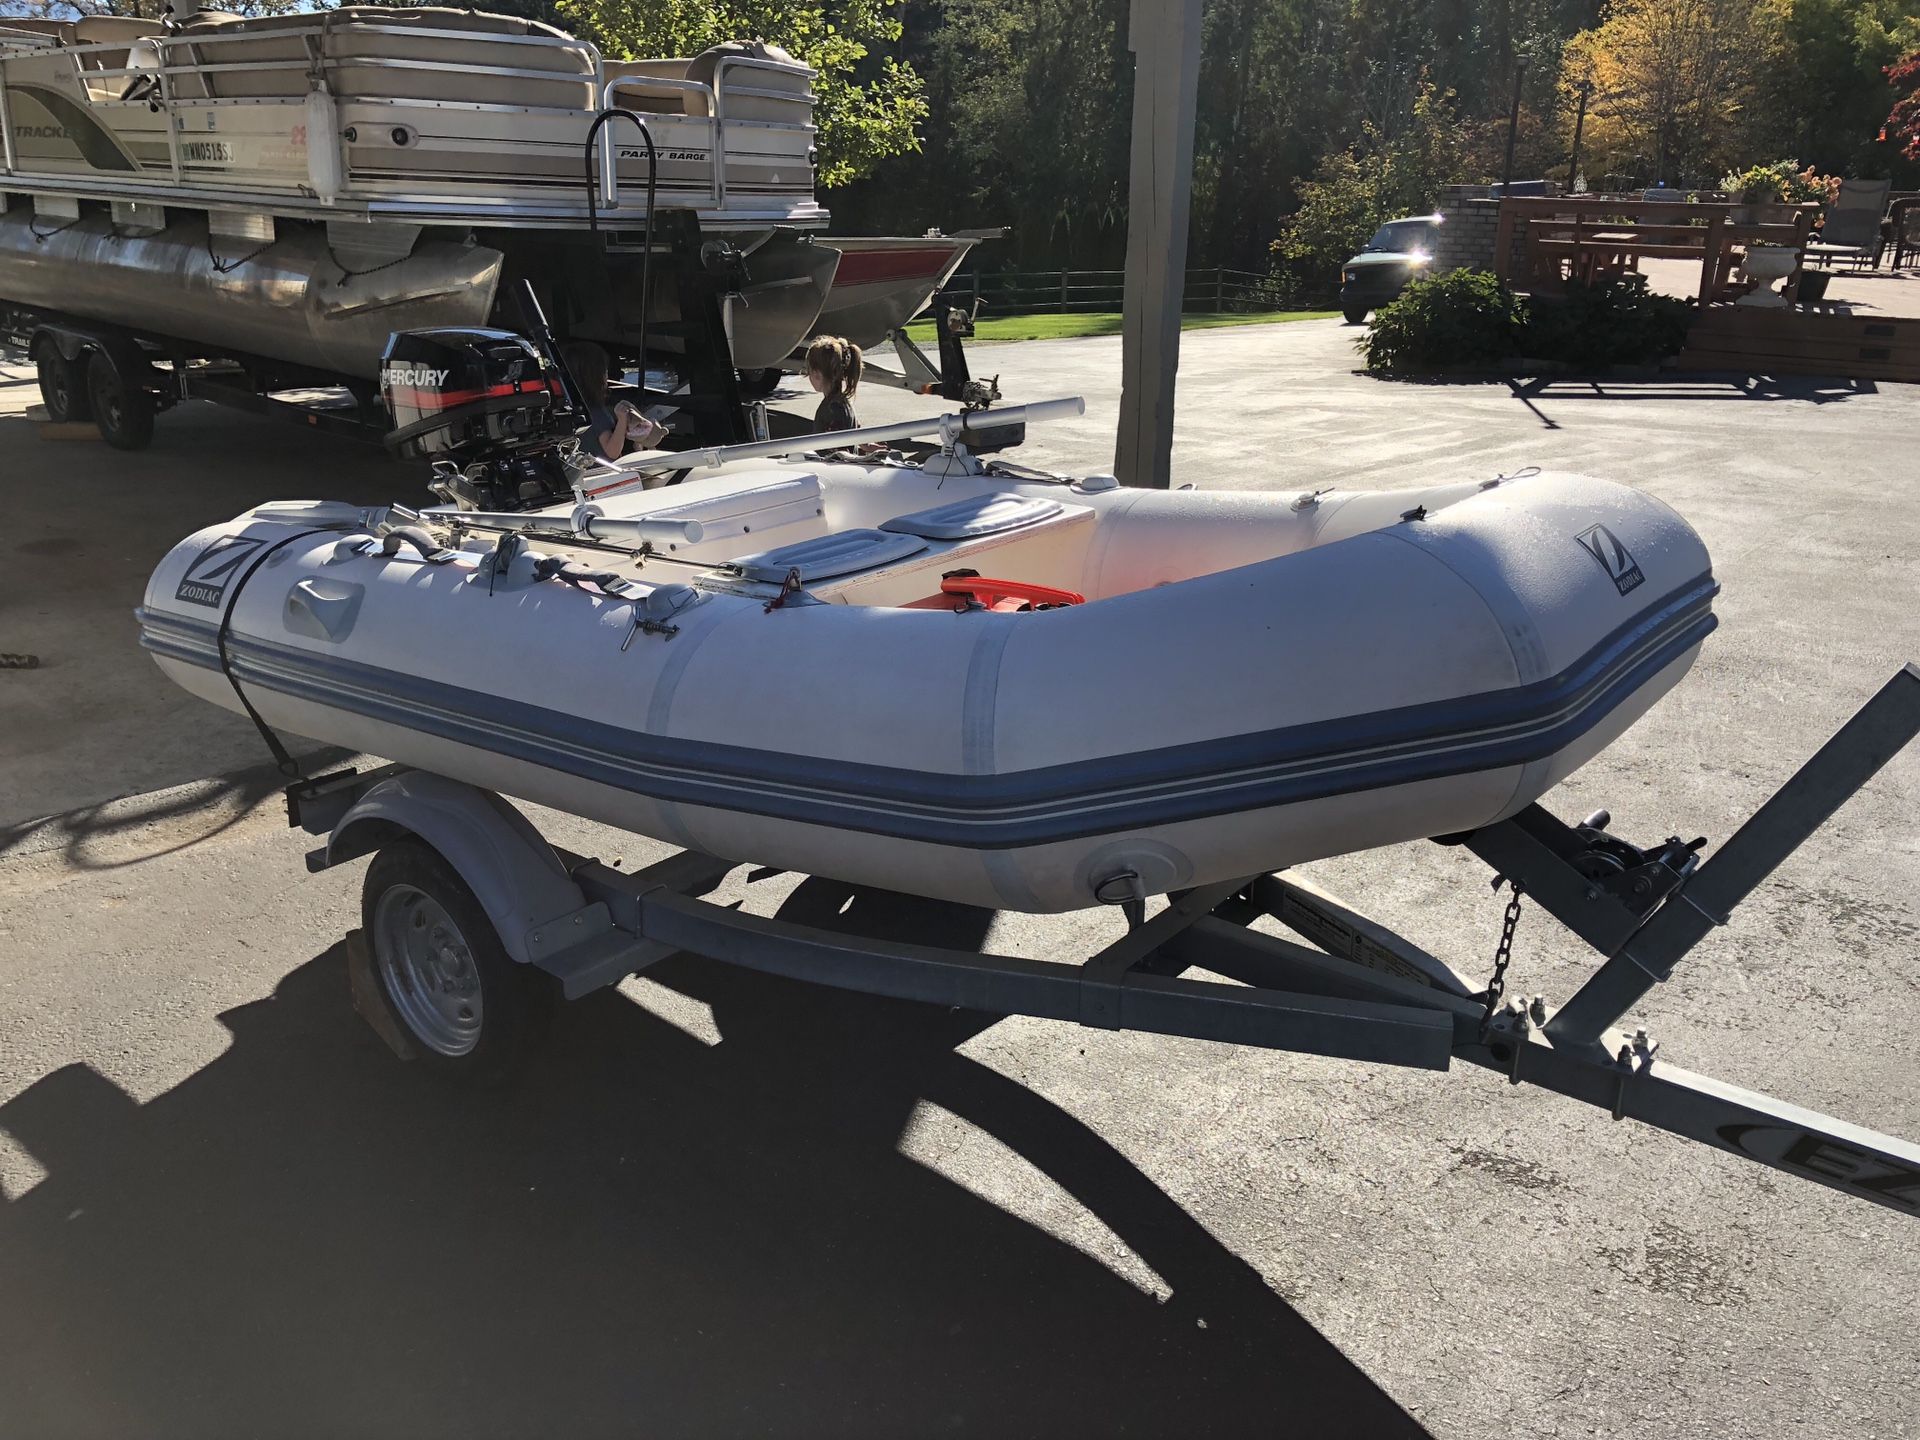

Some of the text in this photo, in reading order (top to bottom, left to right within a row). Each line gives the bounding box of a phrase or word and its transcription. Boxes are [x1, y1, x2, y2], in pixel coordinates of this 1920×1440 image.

[620, 150, 706, 160] PARY BARGE
[381, 369, 449, 387] MERCURY
[179, 584, 220, 604] ZODIAC
